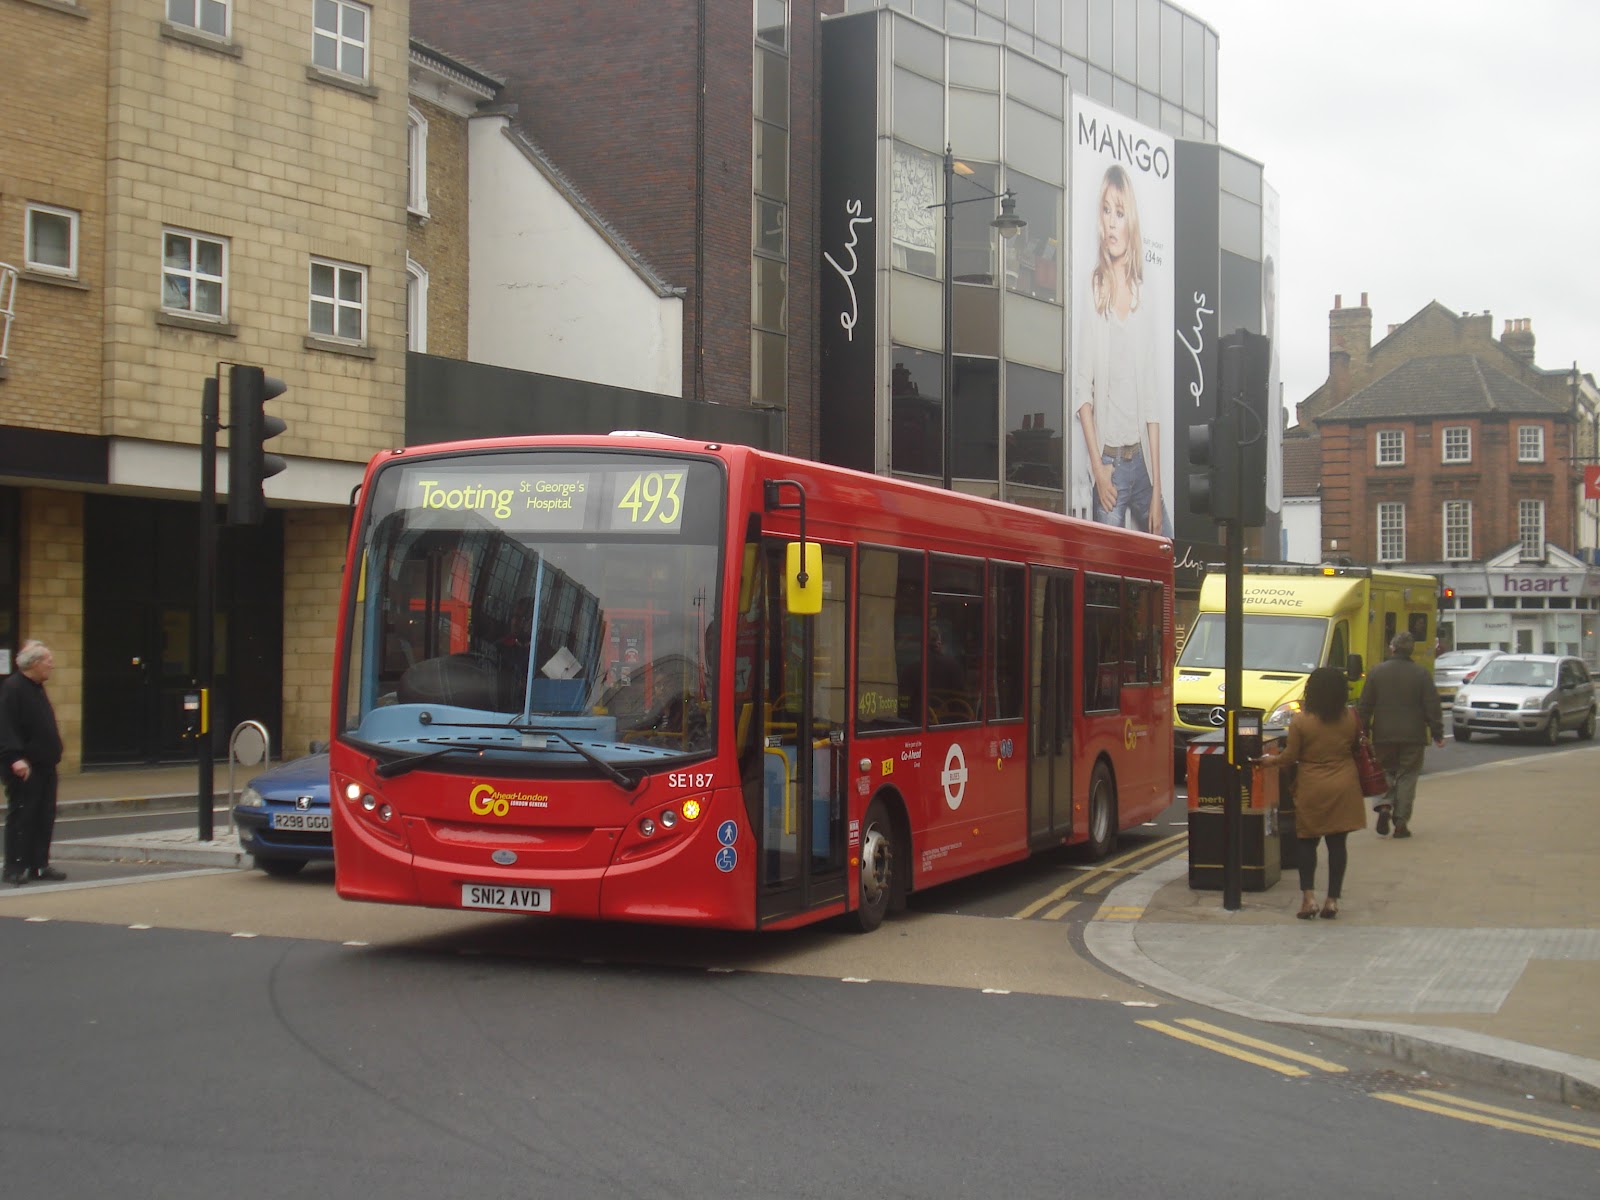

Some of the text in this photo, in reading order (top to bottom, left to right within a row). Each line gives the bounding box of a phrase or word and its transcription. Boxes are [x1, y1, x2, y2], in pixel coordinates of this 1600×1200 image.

[1078, 112, 1170, 179] MANGO
[519, 480, 585, 497] St George's
[418, 480, 514, 519] Tooting
[527, 496, 573, 512] Hospital
[618, 472, 684, 524] 493
[1504, 574, 1569, 592] haart
[1244, 588, 1295, 597] LONDON
[1243, 597, 1304, 607] BULANCE
[859, 692, 876, 714] 493
[668, 773, 713, 788] SE187
[469, 784, 509, 817] Go
[275, 814, 304, 828] R298
[471, 887, 541, 907] SN12 AVD
